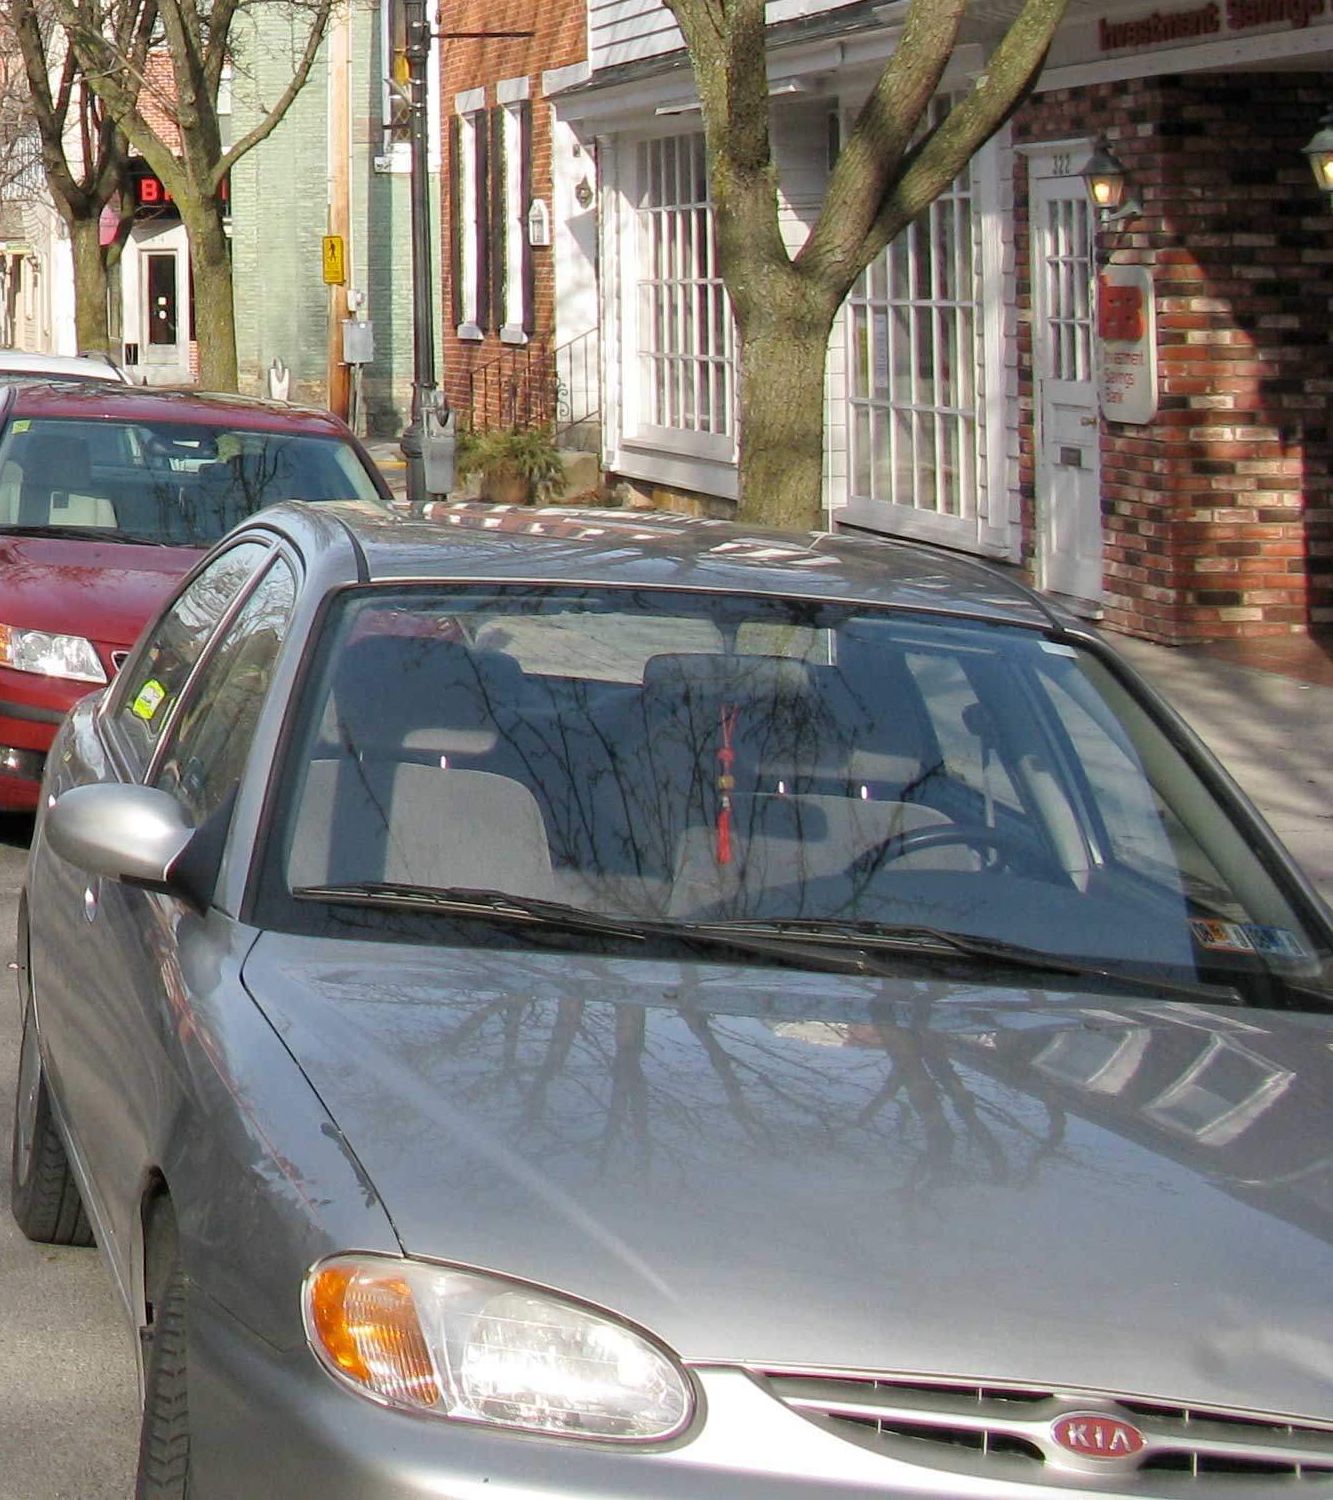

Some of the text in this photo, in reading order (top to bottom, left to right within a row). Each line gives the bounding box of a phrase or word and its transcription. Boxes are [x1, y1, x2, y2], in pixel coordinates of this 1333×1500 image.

[1100, 2, 1220, 52] Investment
[1052, 153, 1070, 175] 322
[1067, 1422, 1132, 1452] KIA
